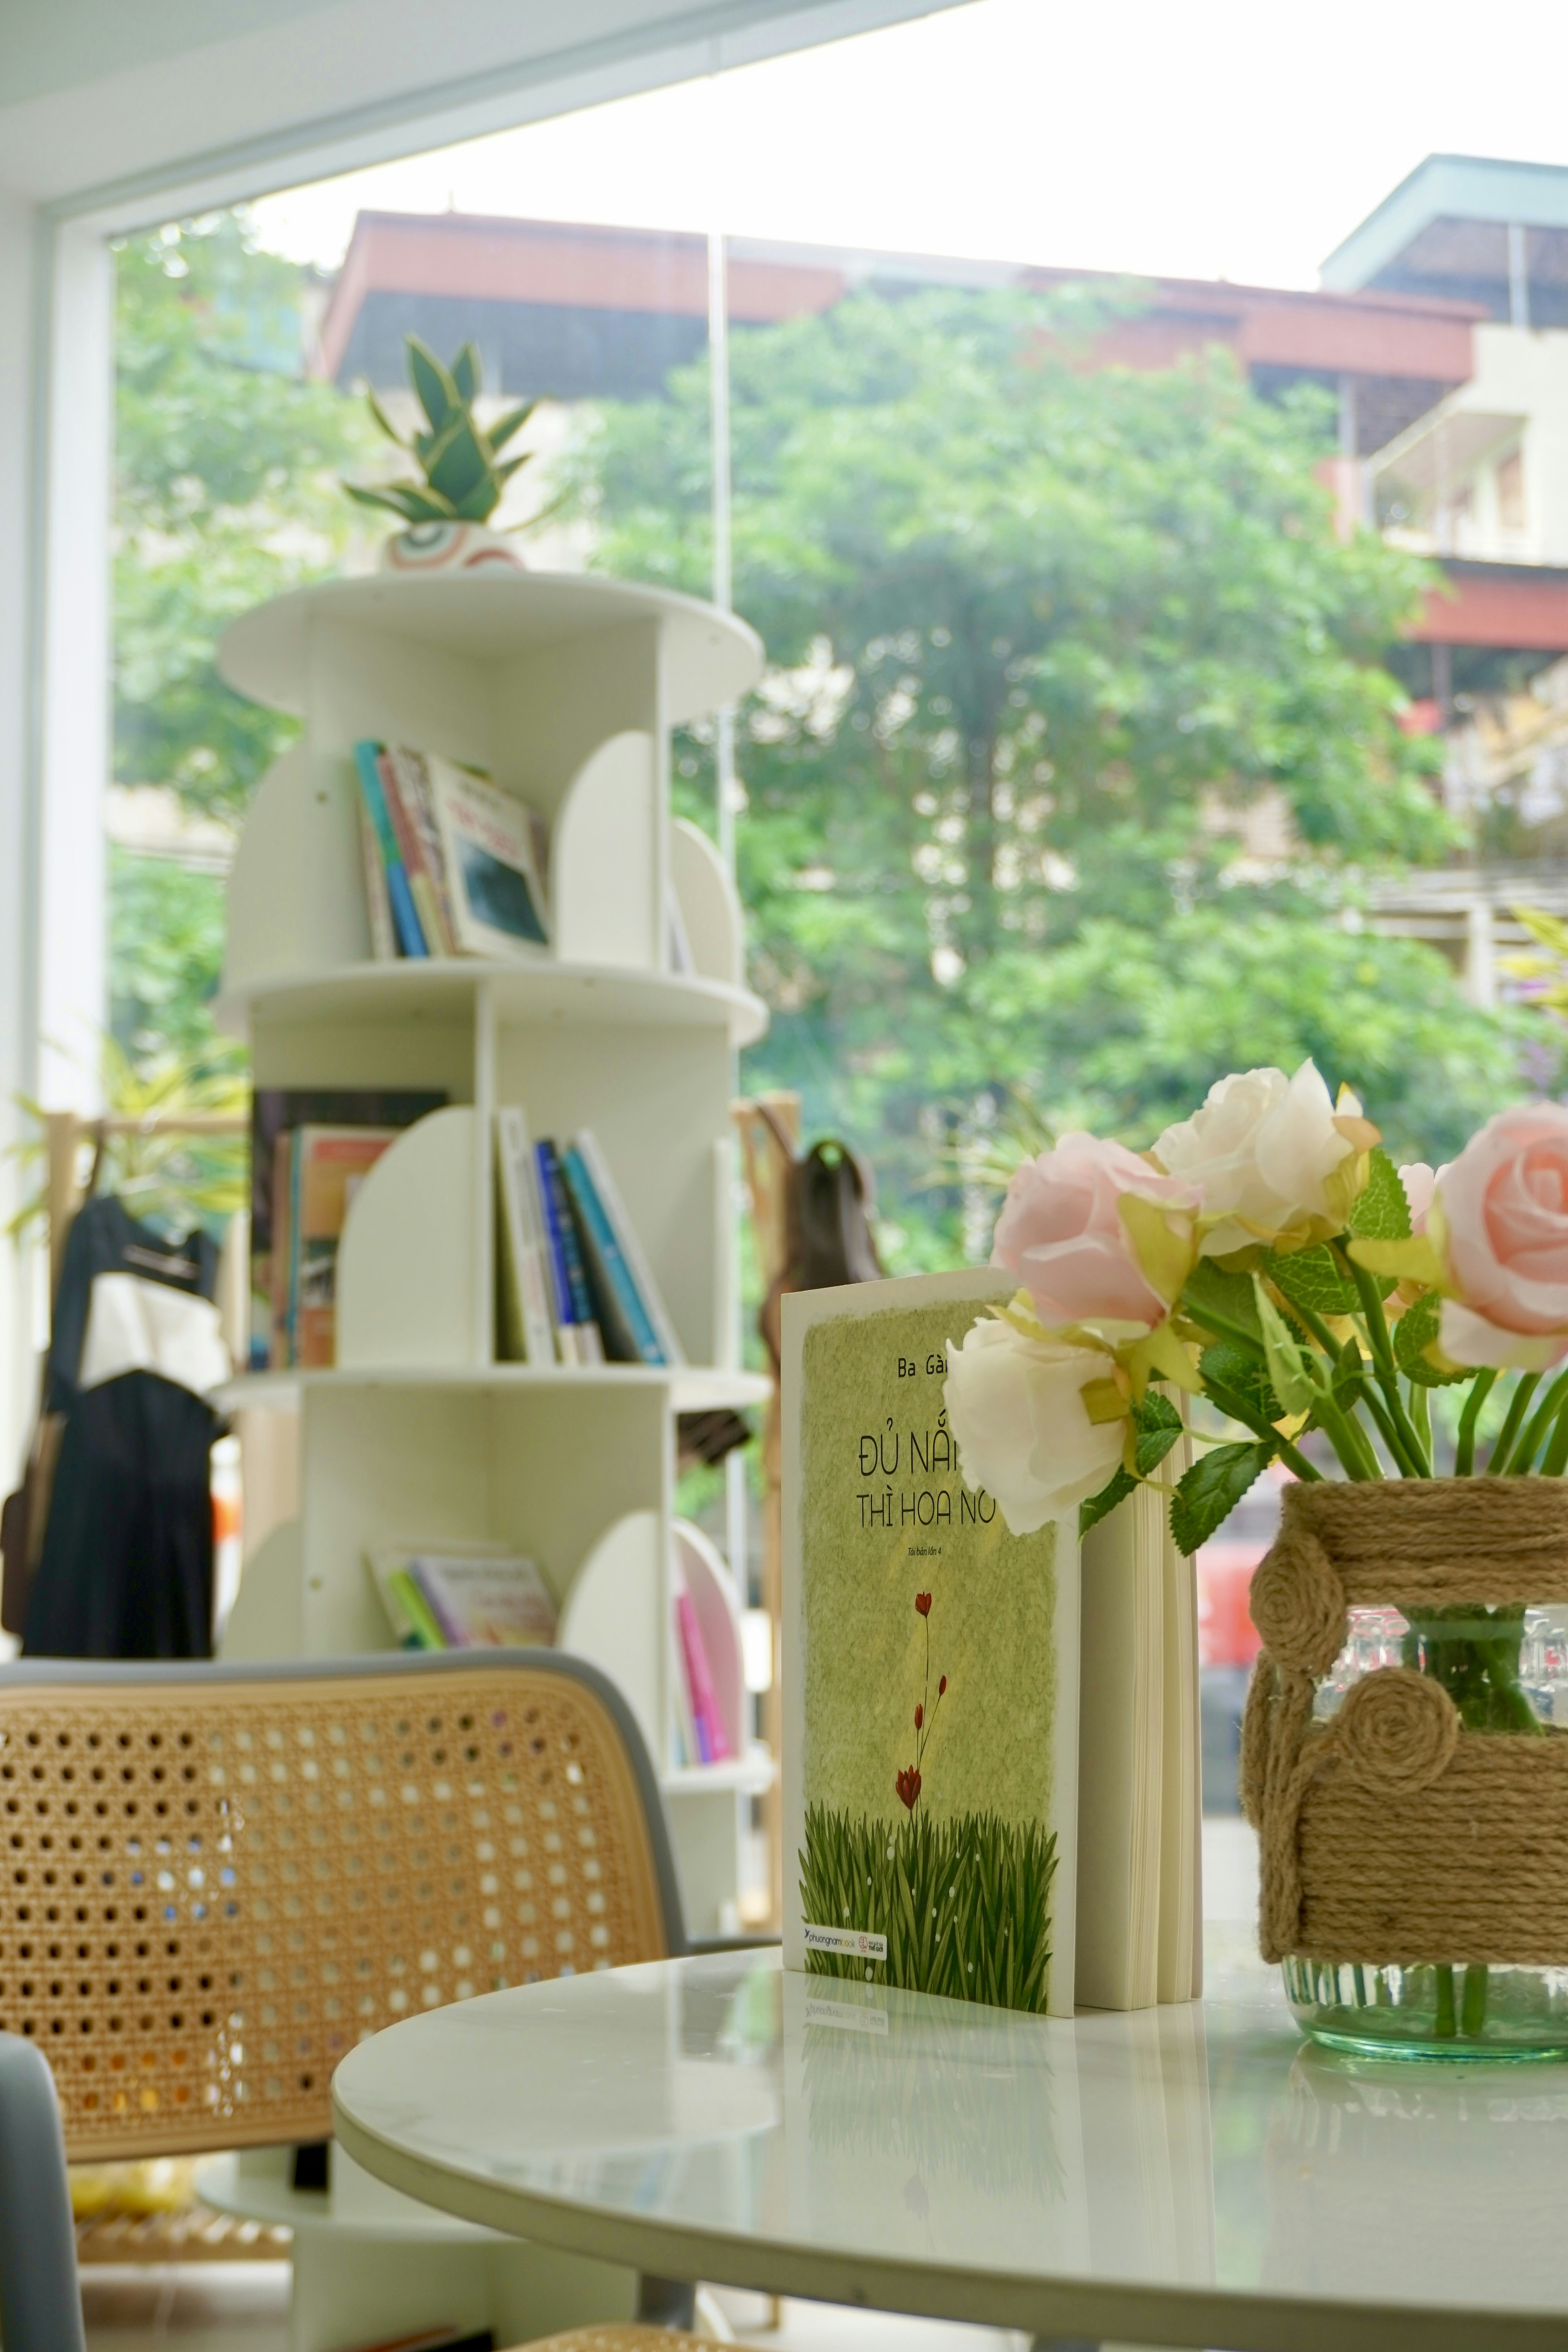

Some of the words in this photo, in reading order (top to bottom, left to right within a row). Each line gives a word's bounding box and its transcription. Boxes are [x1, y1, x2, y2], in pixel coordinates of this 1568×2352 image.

[898, 1358, 915, 1377] Ba
[926, 1354, 947, 1375] Gà
[858, 1417, 898, 1476] ĐỦ
[911, 1409, 956, 1474] NẮ
[856, 1485, 893, 1528] THÌ
[902, 1490, 951, 1526] HOA
[916, 1547, 927, 1556] bản
[928, 1546, 936, 1555] lần
[938, 1547, 941, 1555] 4
[809, 1933, 855, 1948] phuongnambook
